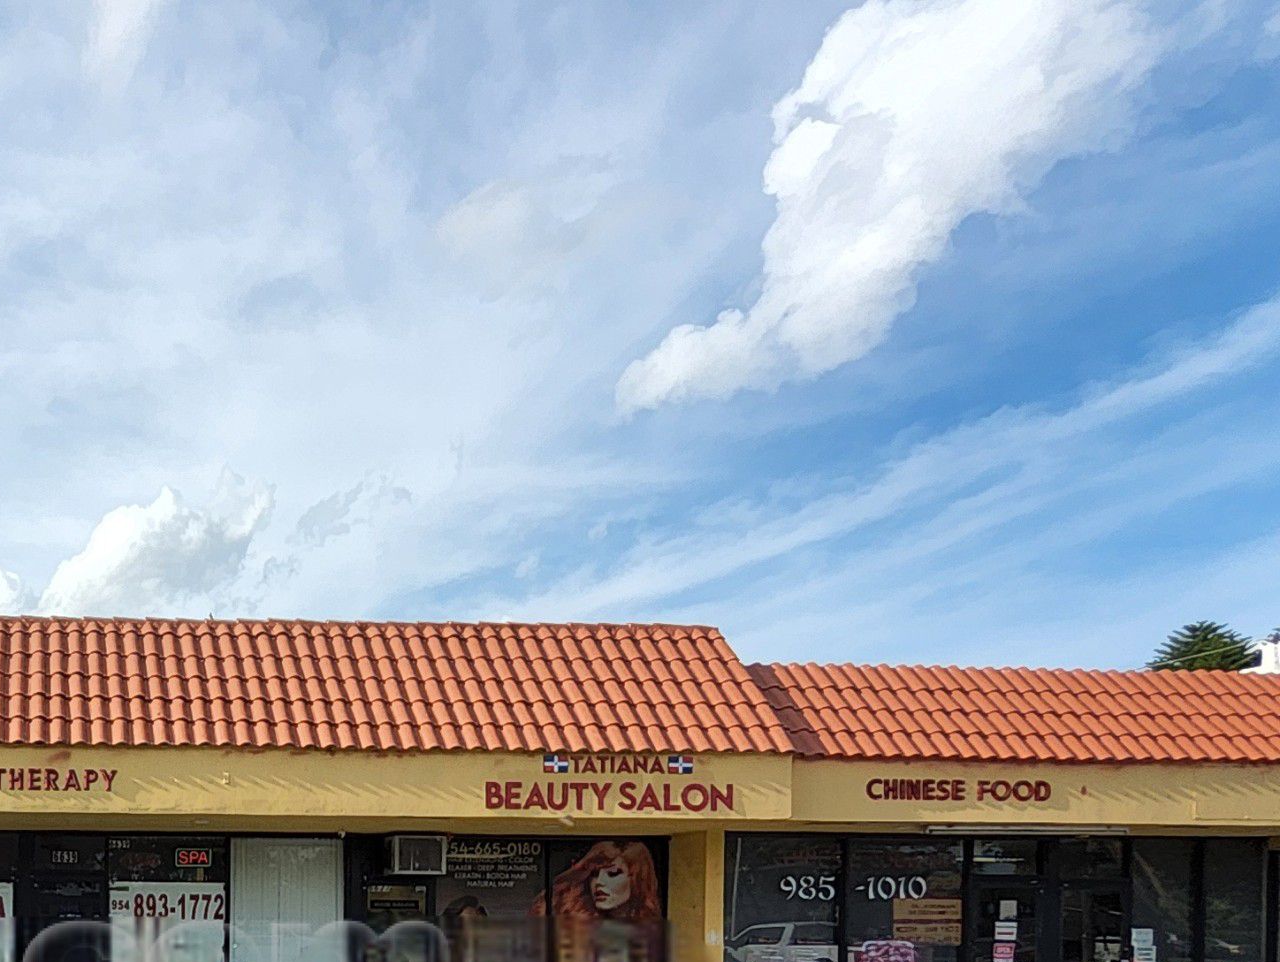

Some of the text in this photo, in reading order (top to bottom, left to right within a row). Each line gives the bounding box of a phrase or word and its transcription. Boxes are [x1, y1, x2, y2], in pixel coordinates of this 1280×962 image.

[571, 755, 666, 774] TATIANA
[485, 782, 733, 812] BEAUTY SALON
[866, 779, 1051, 801] CHINESE FOOD
[178, 851, 208, 864] SPA
[449, 842, 541, 855] 54-665-0180
[780, 876, 836, 900] 985
[111, 893, 224, 920] 954 893-1772
